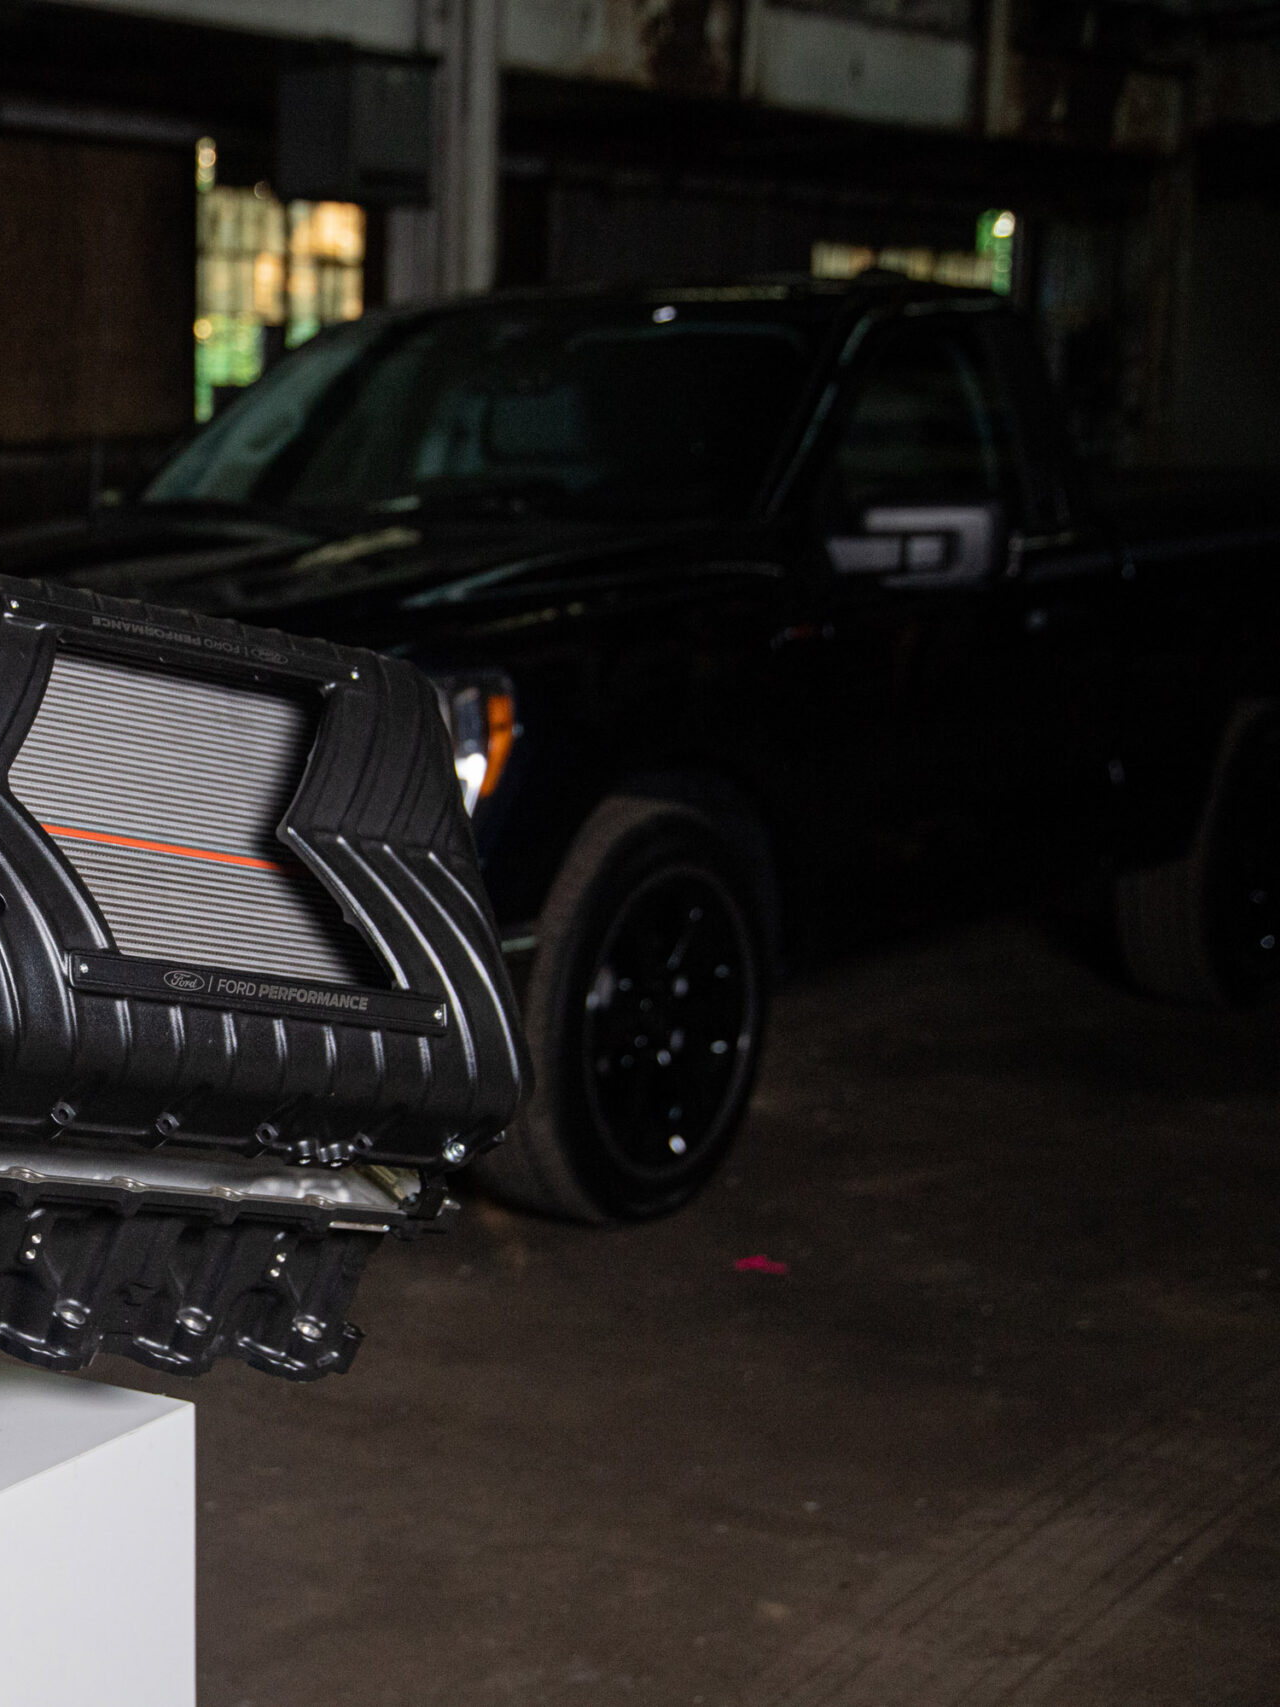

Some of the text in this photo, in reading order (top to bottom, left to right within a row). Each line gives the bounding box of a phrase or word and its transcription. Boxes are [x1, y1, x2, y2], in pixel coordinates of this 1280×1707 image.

[91, 615, 201, 646] PERFORMANCE
[169, 972, 369, 1010] Ford FORD PERFORMANCE
